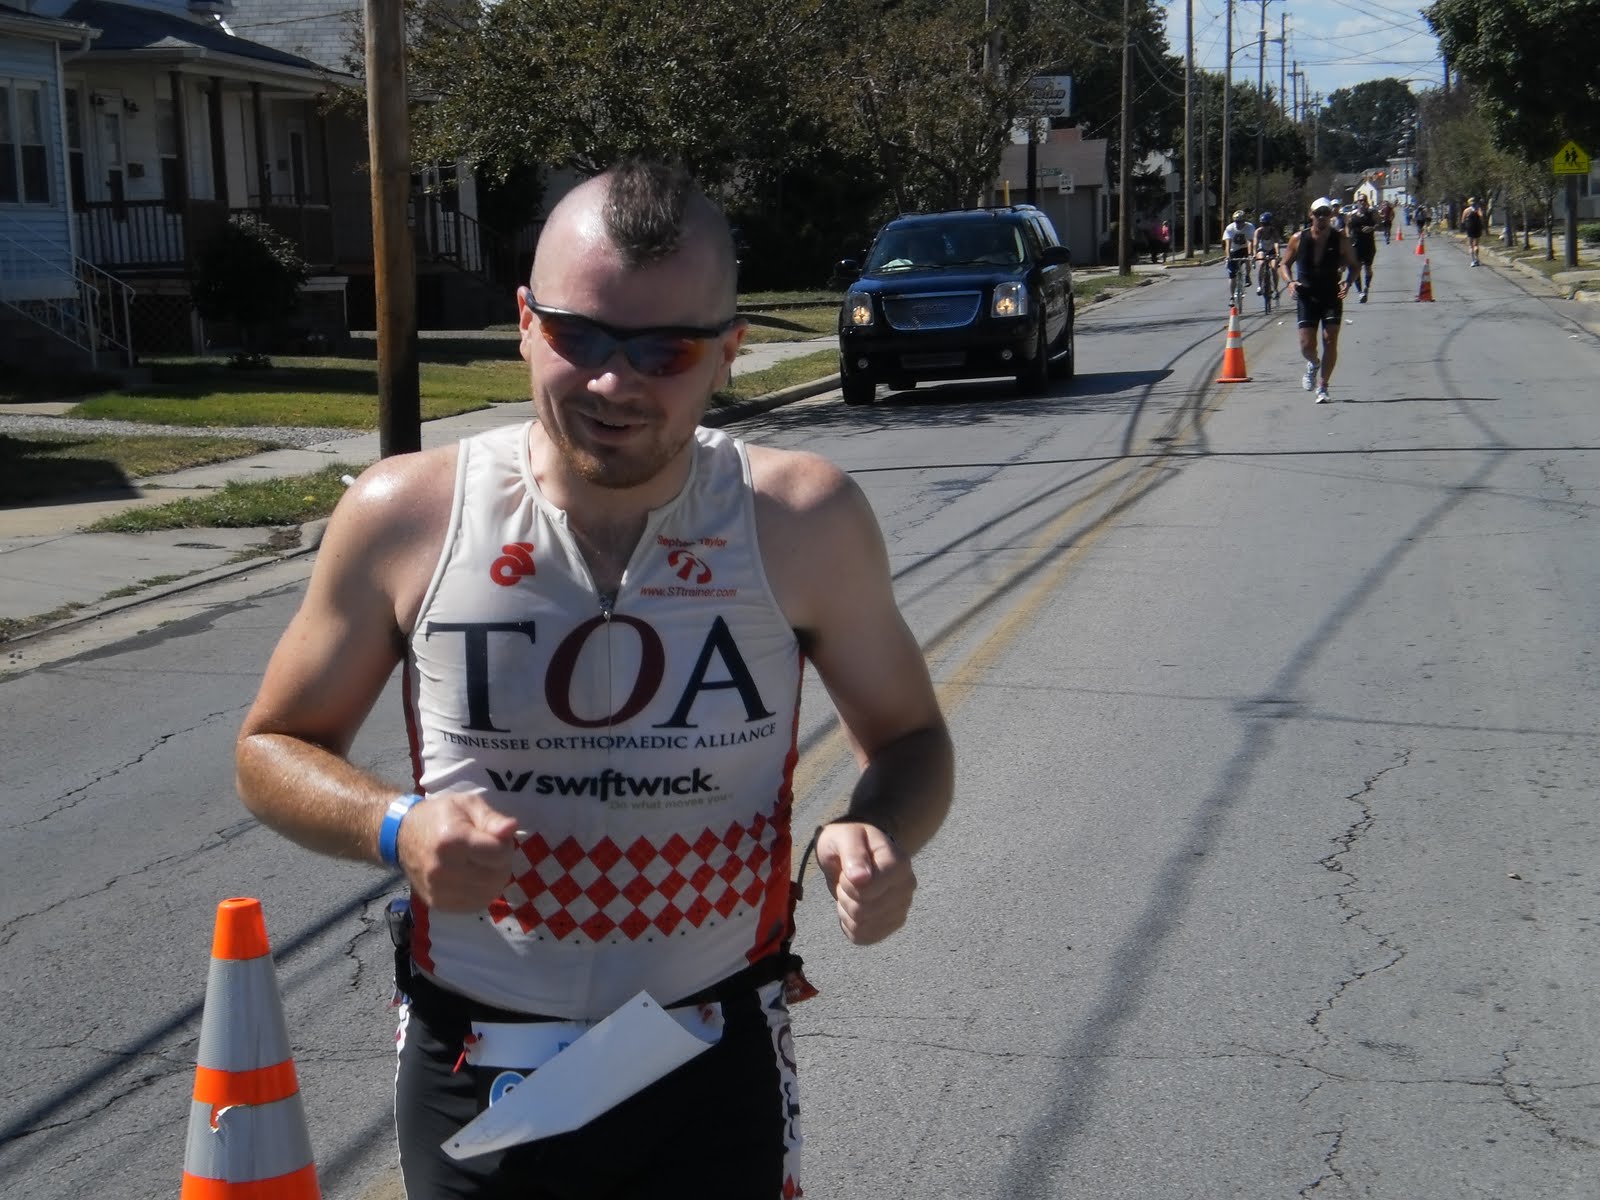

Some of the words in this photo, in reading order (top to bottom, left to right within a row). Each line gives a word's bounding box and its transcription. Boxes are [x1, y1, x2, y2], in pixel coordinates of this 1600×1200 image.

[426, 614, 777, 733] TOA
[440, 729, 530, 751] TENNESSEE
[536, 735, 689, 751] ORTHOPAEDIC
[695, 721, 777, 749] ALLIANCE
[631, 799, 661, 810] what
